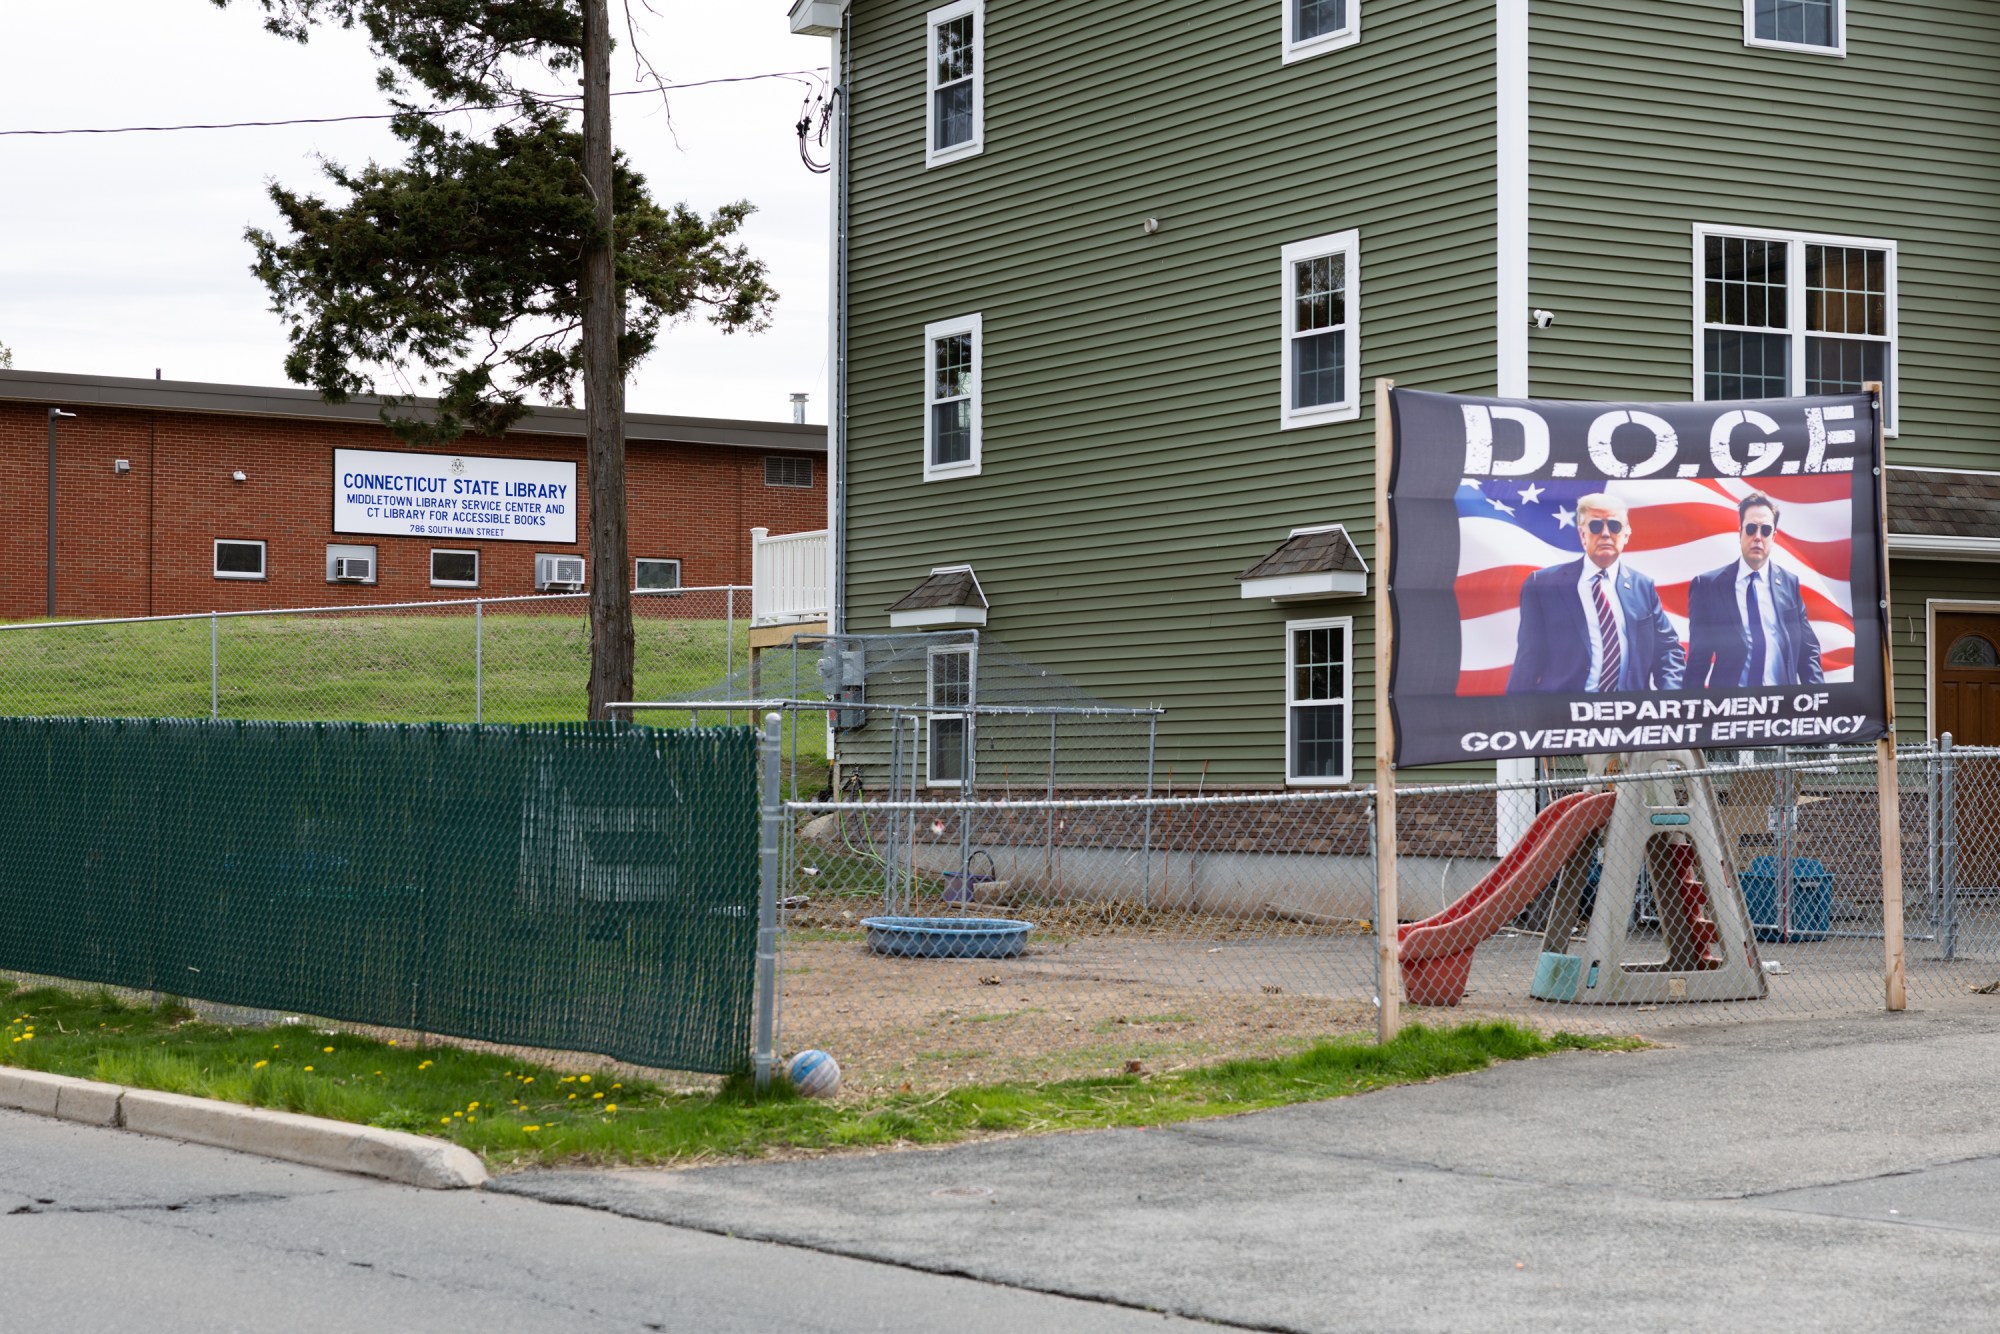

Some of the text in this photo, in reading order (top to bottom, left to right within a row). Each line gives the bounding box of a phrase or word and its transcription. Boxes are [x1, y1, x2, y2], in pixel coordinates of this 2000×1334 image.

[1460, 403, 1855, 478] D.O.G.E
[343, 473, 567, 499] CONNECTICUT STATE LIBRARY
[347, 494, 565, 514] MIDDLETOWN LIBRARY SERVICE CENTER AND
[367, 507, 546, 526] CT LIBRARY FOR ACCESSIBLE BOOKS
[410, 524, 504, 536] 786 SOUTH MAIN STREET
[1570, 692, 1829, 722] DEPARTMENT OF
[1460, 715, 1866, 752] GOVERNMENT EFFICIENCY
